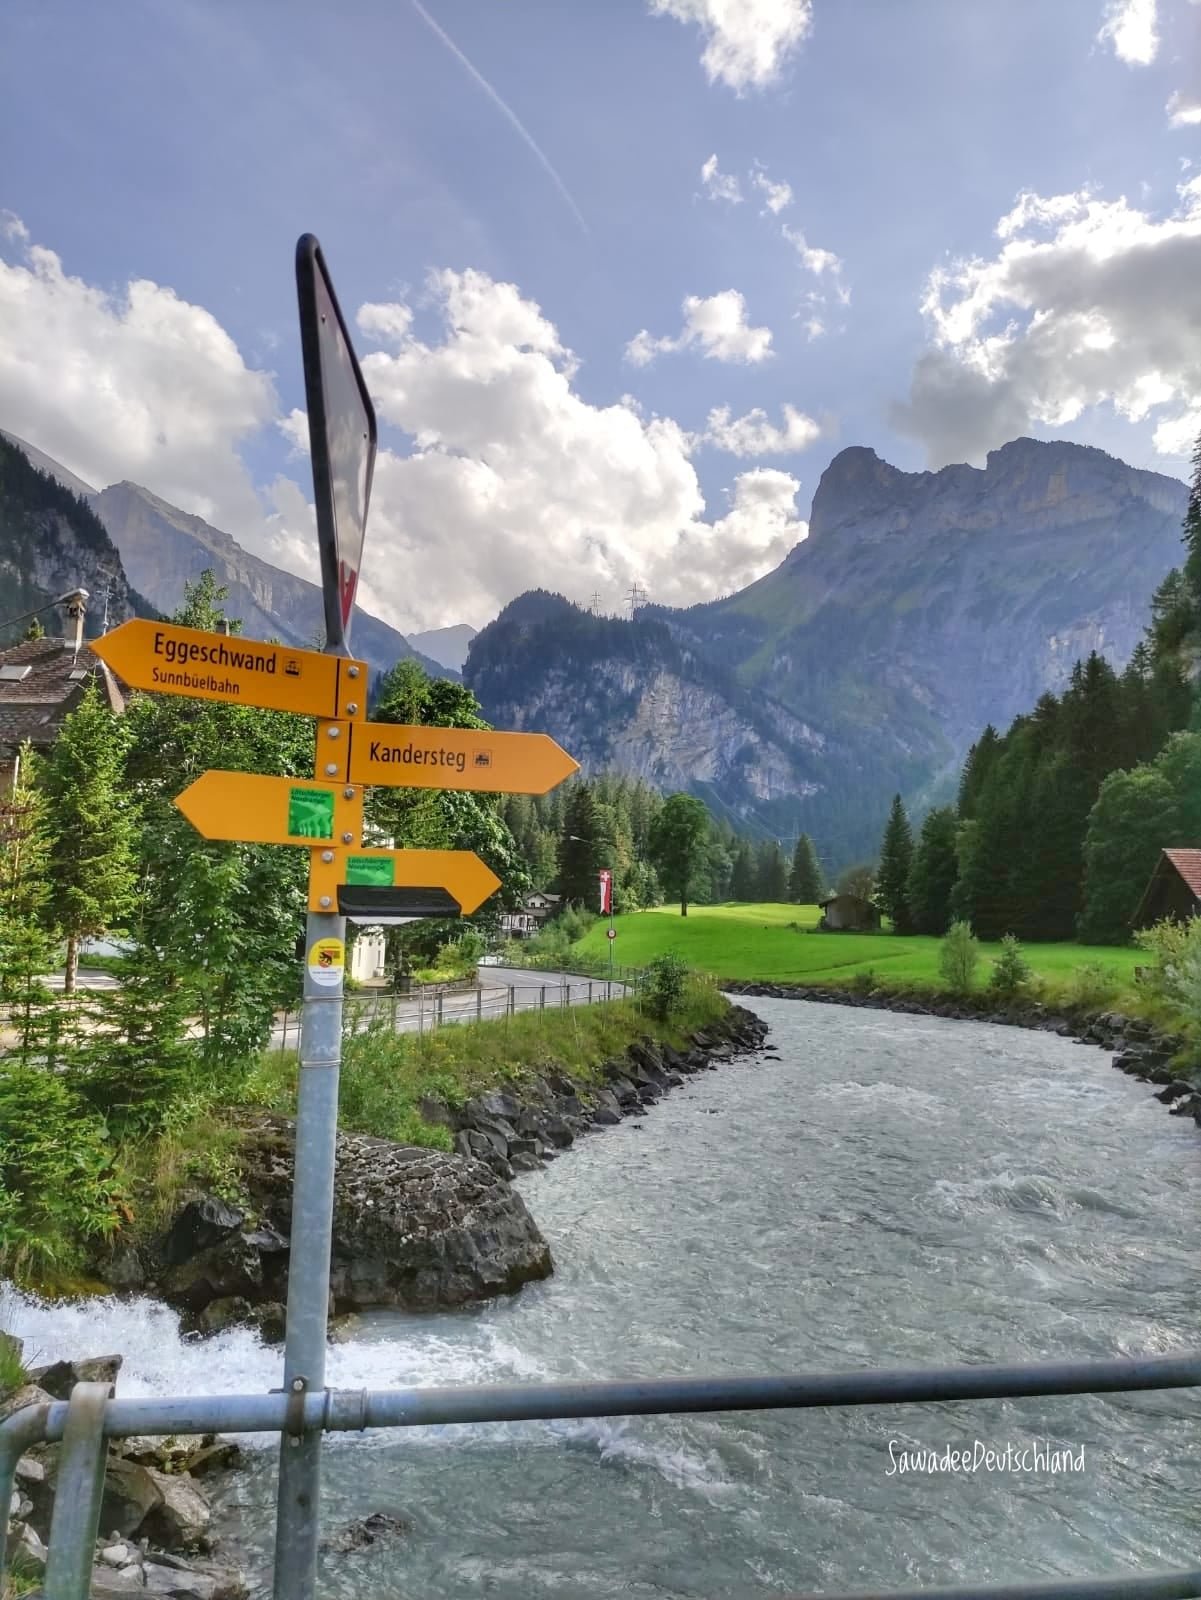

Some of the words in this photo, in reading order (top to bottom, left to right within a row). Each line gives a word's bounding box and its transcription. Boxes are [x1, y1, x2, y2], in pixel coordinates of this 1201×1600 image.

[154, 632, 276, 674] Eggeschwand
[152, 667, 240, 695] Sunnbüelbahn
[370, 742, 466, 772] Kandersteg
